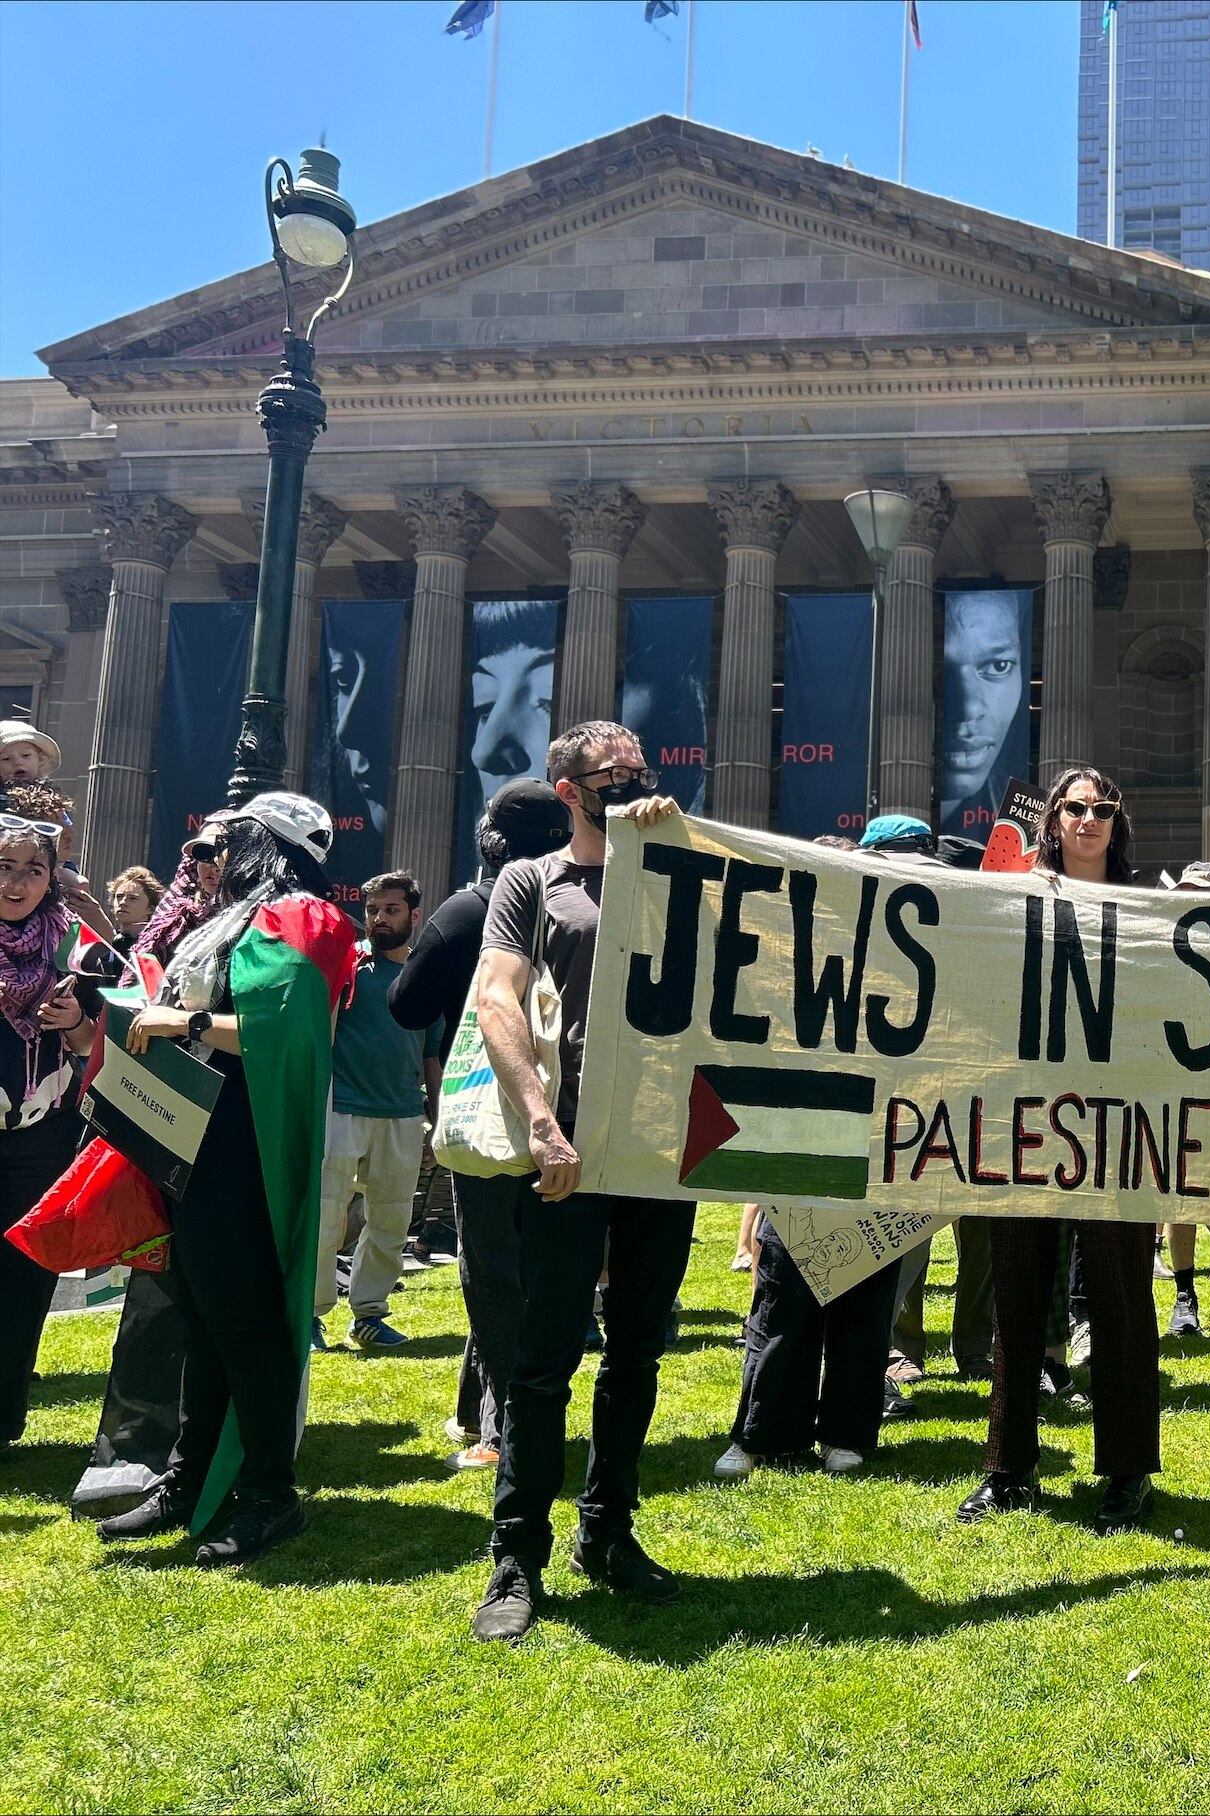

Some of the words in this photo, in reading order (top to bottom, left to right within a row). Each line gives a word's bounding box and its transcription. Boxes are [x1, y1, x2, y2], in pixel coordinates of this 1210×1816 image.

[528, 412, 815, 441] VICTORIA
[1013, 792, 1045, 811] STAND
[837, 813, 864, 829] on
[625, 842, 939, 1057] JEWS
[1018, 895, 1118, 1063] IN
[457, 1030, 477, 1044] THE
[120, 1076, 137, 1096] FREE
[137, 1091, 177, 1126] PALESTINE
[895, 1220, 911, 1236] OF
